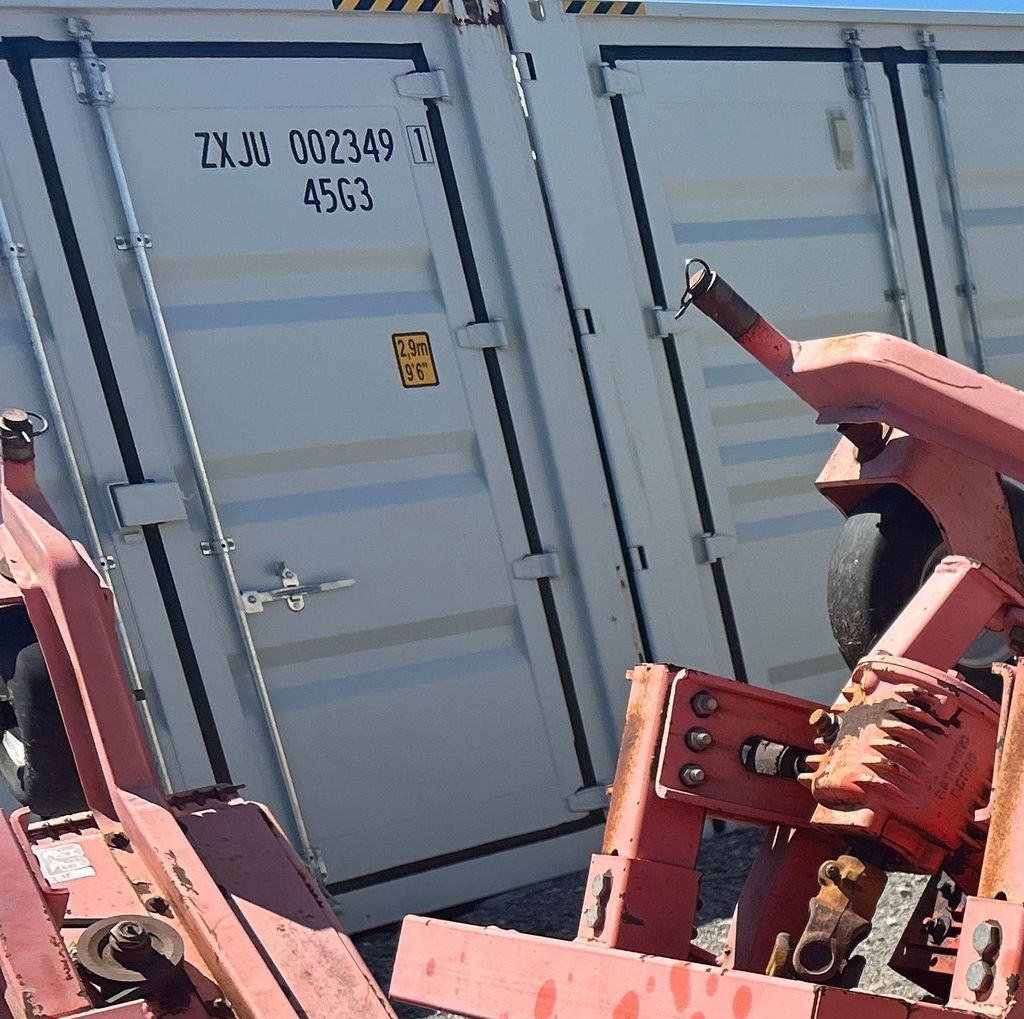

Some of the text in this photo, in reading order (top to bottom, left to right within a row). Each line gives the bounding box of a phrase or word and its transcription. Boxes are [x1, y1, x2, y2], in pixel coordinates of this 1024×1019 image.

[194, 127, 428, 168] ZXJU 002349 1
[304, 177, 374, 213] 45G3
[397, 338, 429, 360] 2,9m
